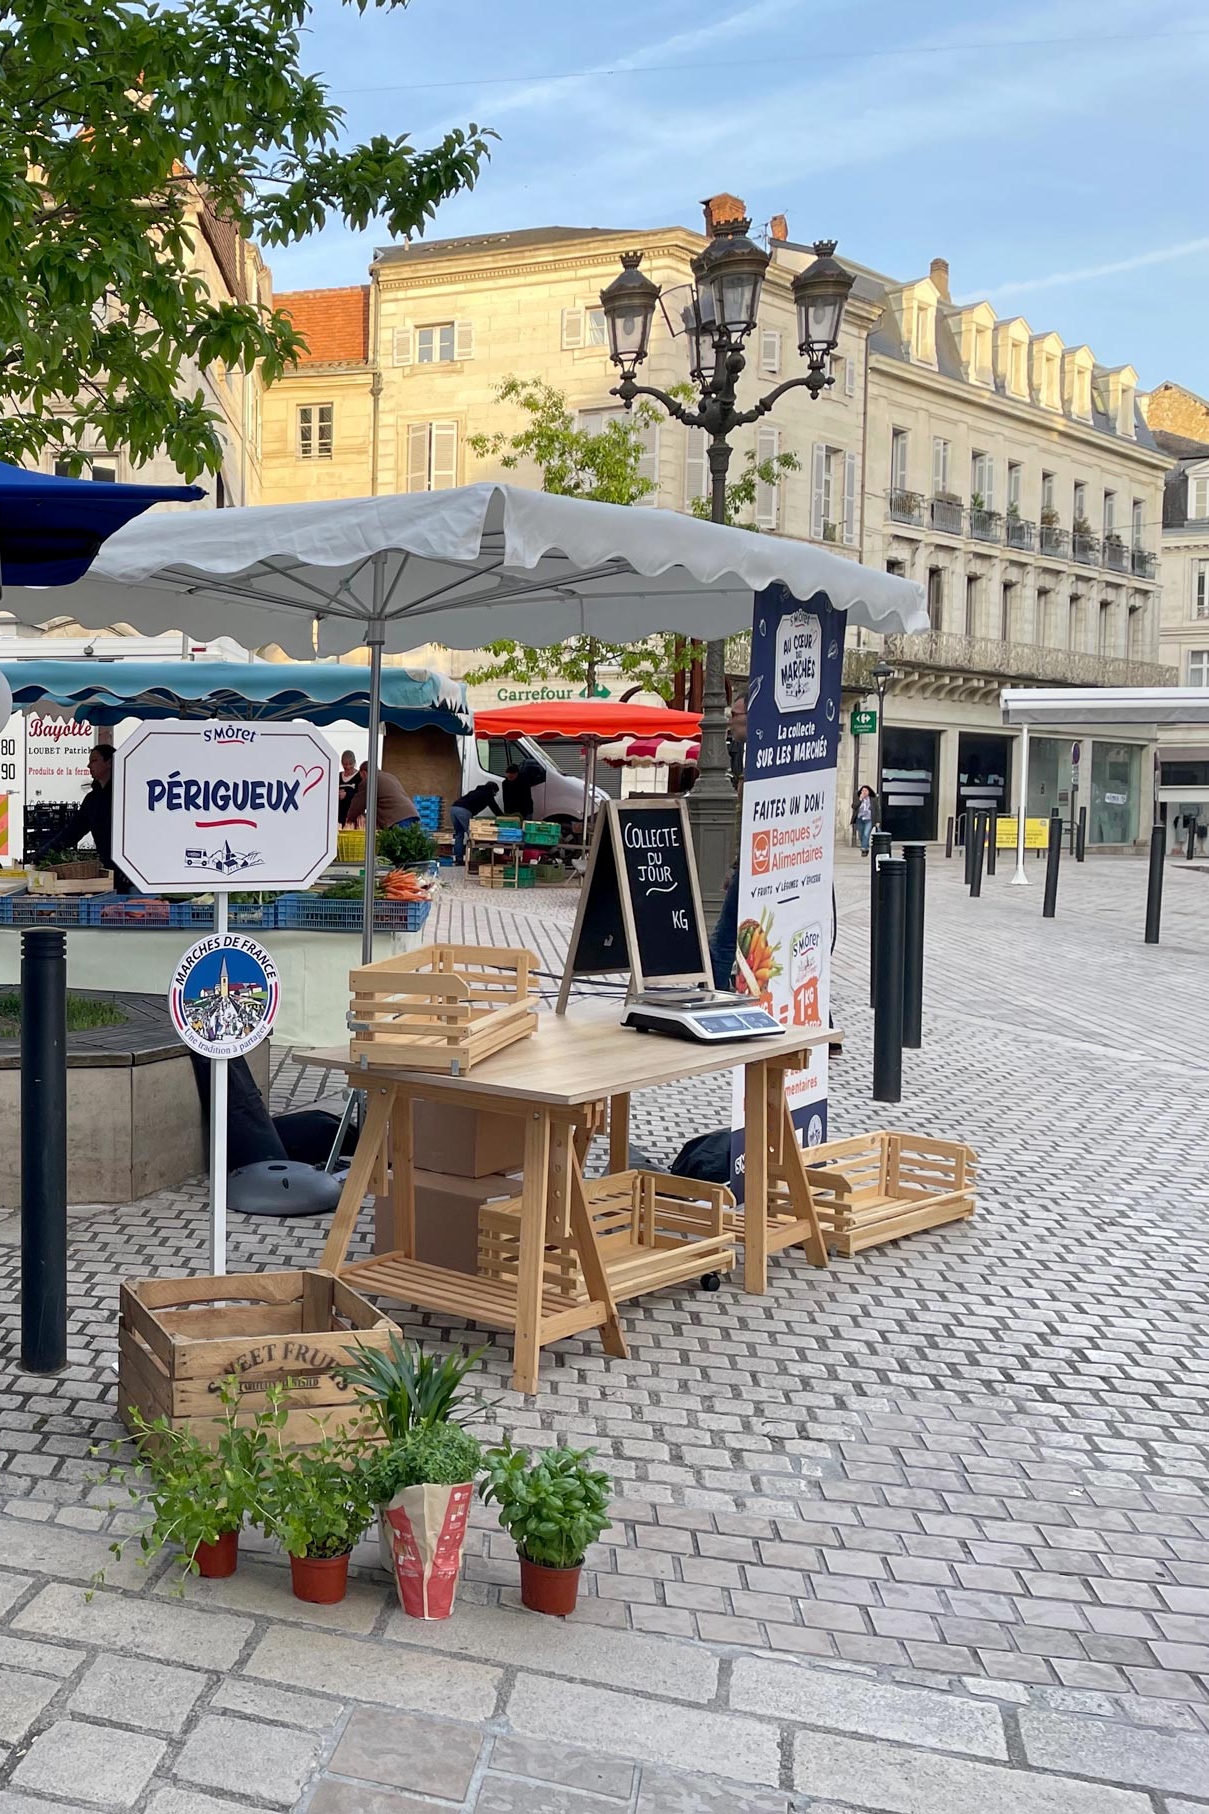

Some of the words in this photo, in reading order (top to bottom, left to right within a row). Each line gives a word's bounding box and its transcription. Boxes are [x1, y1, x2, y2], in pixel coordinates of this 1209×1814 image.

[784, 637, 792, 655] AU
[781, 656, 816, 686] MARCHÉS
[497, 686, 573, 701] Carrefour
[777, 725, 787, 740] La
[788, 721, 816, 738] collecte
[1, 739, 15, 756] 80
[28, 747, 61, 755] LOUBET
[756, 747, 773, 769] SUR
[776, 745, 791, 766] LES
[793, 735, 828, 761] MARCHÉS
[1, 763, 15, 780] 90
[28, 767, 54, 777] Produits
[56, 767, 64, 776] de
[66, 767, 72, 776] la
[74, 767, 93, 776] ferm
[146, 770, 301, 814] PÉRIGUEUX
[753, 798, 786, 822] FAITES
[790, 797, 801, 816] UN
[624, 822, 680, 848] COLLECTE
[772, 825, 811, 847] Banques
[647, 852, 662, 866] DU
[771, 845, 823, 872] Alimentaires
[638, 866, 673, 882] JOUR
[672, 909, 689, 931] KG
[175, 937, 221, 986] MARCHES
[223, 936, 240, 947] DE
[241, 939, 276, 979] FRANCE
[184, 1028, 198, 1045] Une
[197, 1042, 231, 1055] tradition
[233, 1045, 238, 1053] à
[239, 1024, 268, 1052] partager
[785, 1076, 818, 1096] mentaires
